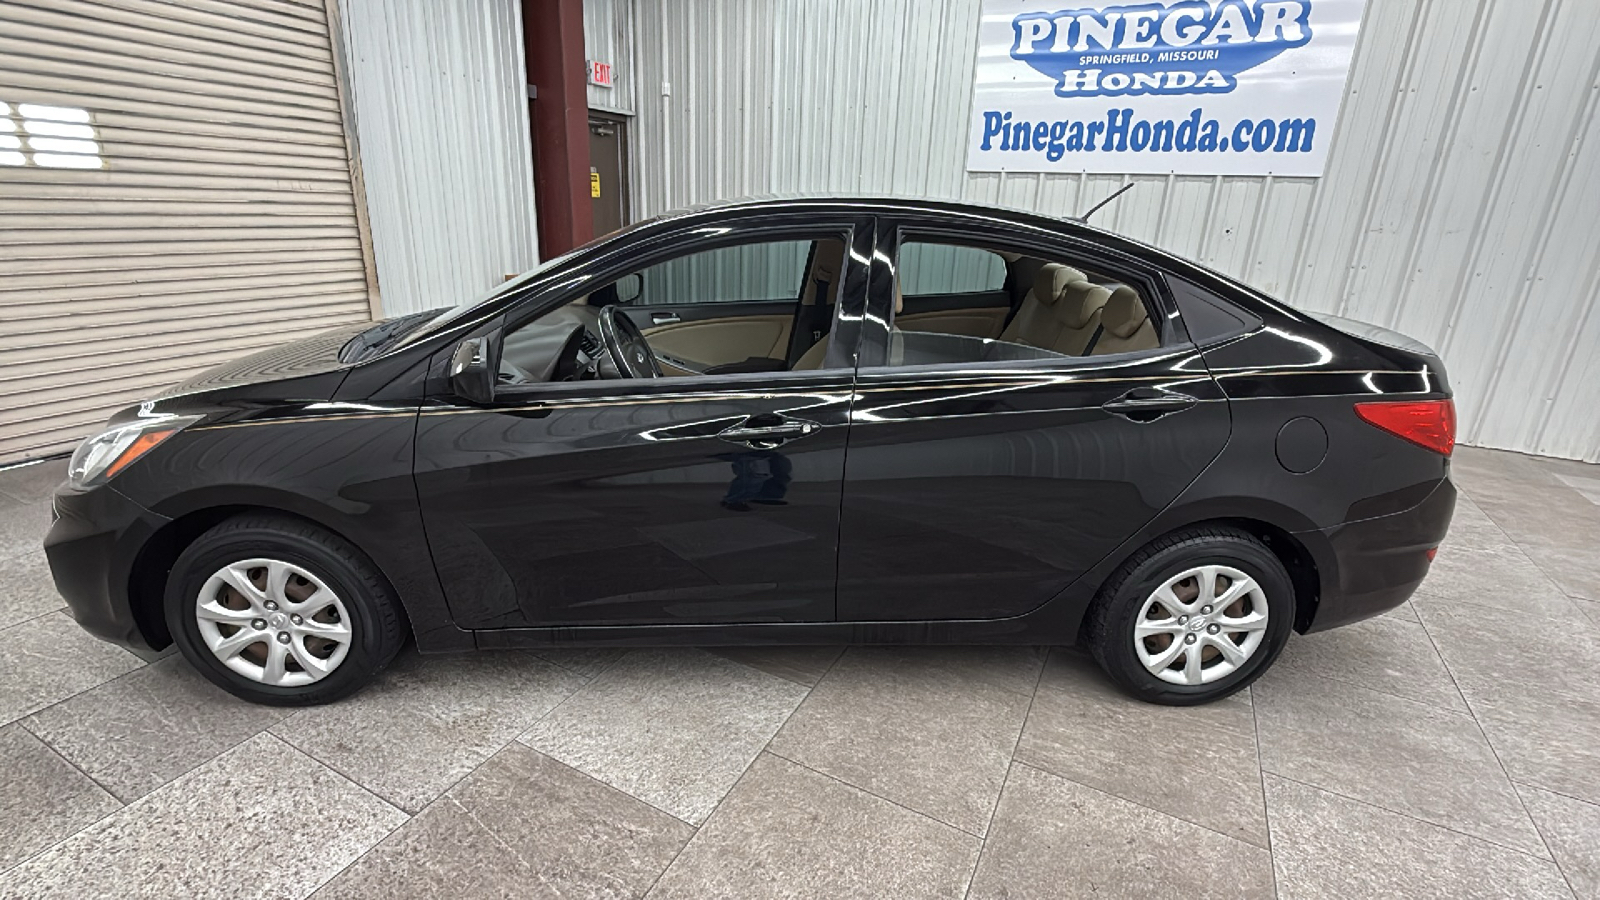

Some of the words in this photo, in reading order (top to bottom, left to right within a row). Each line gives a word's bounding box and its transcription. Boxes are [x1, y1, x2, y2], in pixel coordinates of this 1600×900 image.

[1015, 1, 1305, 55] PINEGAR
[1079, 52, 1154, 65] SPRINGFIELD,
[1157, 50, 1219, 63] MISSOURI
[594, 62, 610, 84] EXIT
[1059, 68, 1230, 93] HONDA
[980, 108, 1316, 162] PinegarHonda.com
